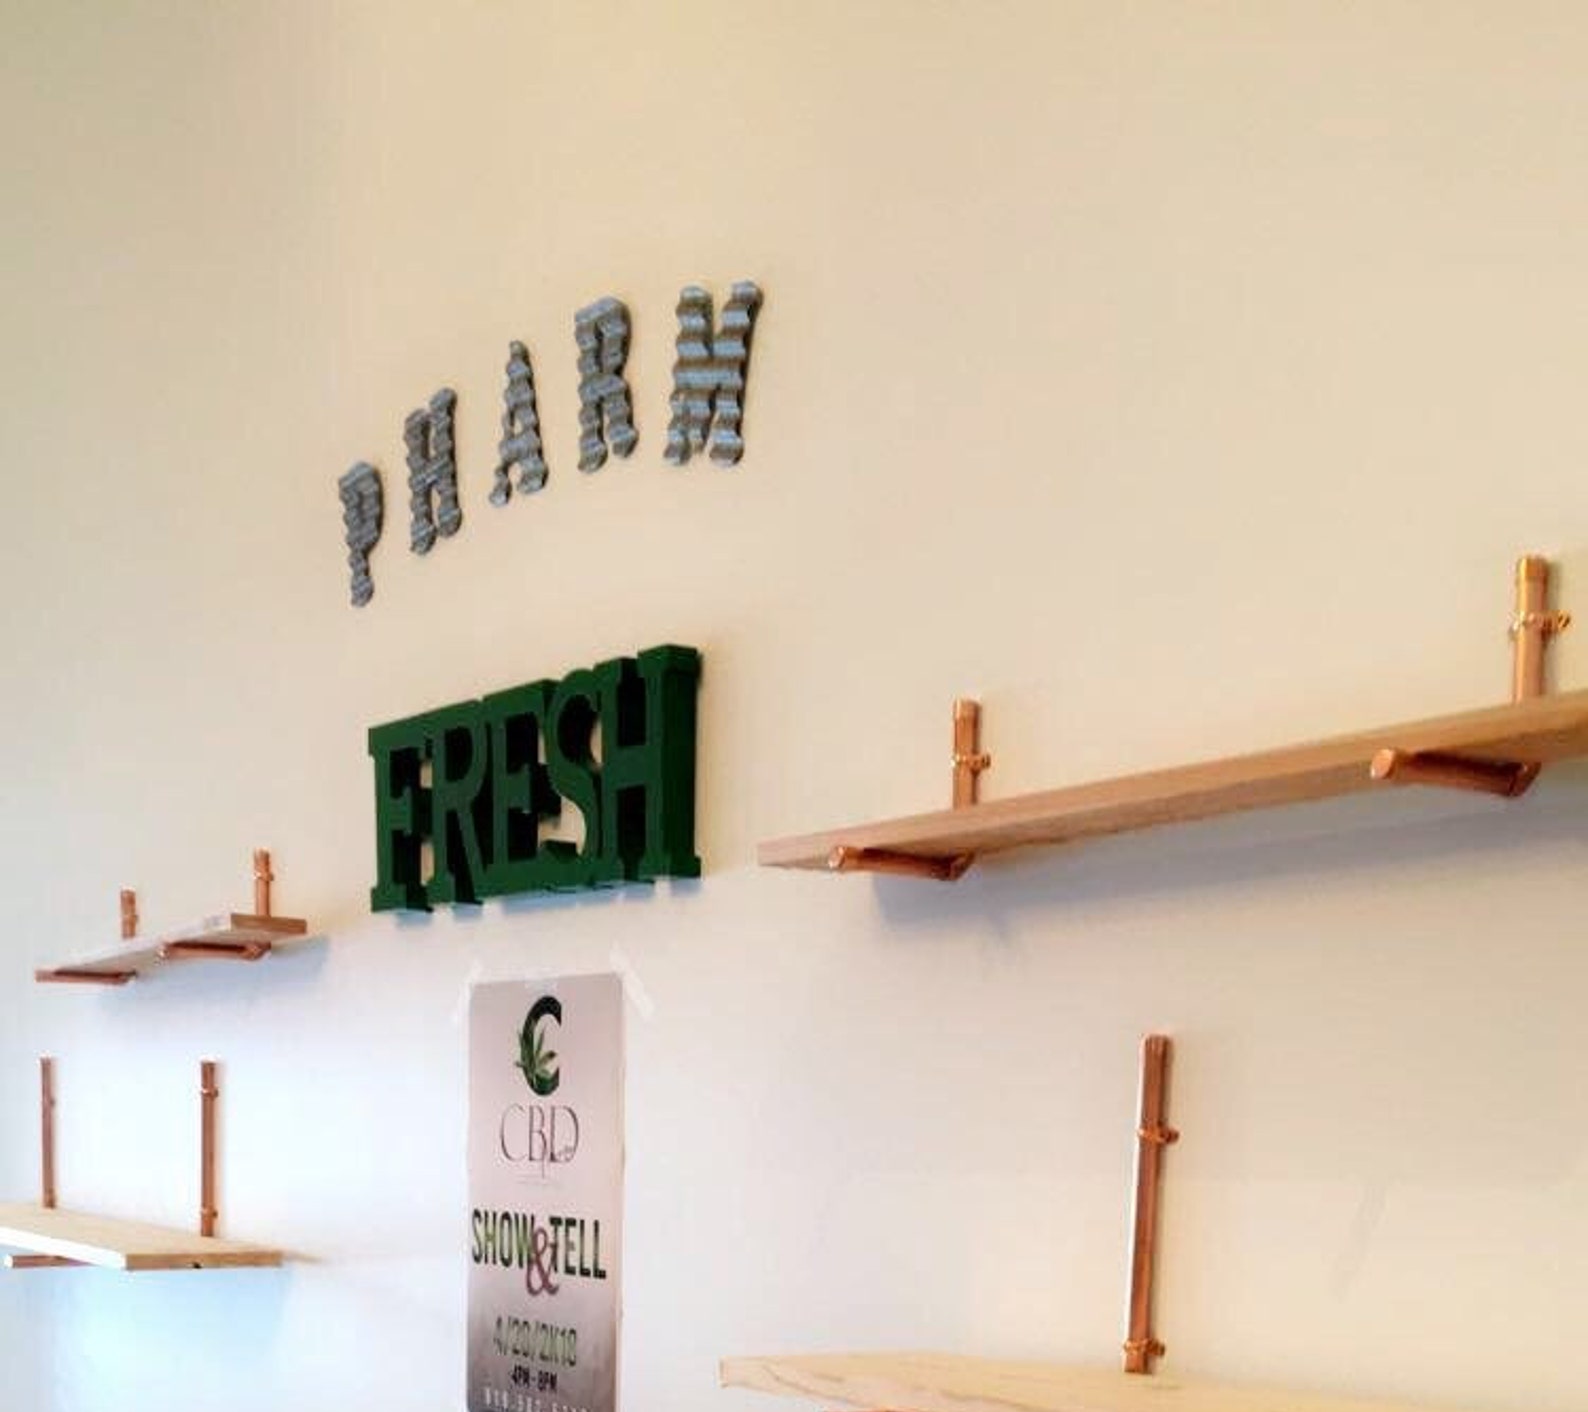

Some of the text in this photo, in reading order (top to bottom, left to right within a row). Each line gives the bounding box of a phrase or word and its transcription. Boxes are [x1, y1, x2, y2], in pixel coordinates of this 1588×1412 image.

[339, 280, 762, 606] PHARM
[368, 643, 702, 913] FRESH
[500, 1103, 579, 1163] CBD
[471, 1208, 607, 1296] SHOW & TELL
